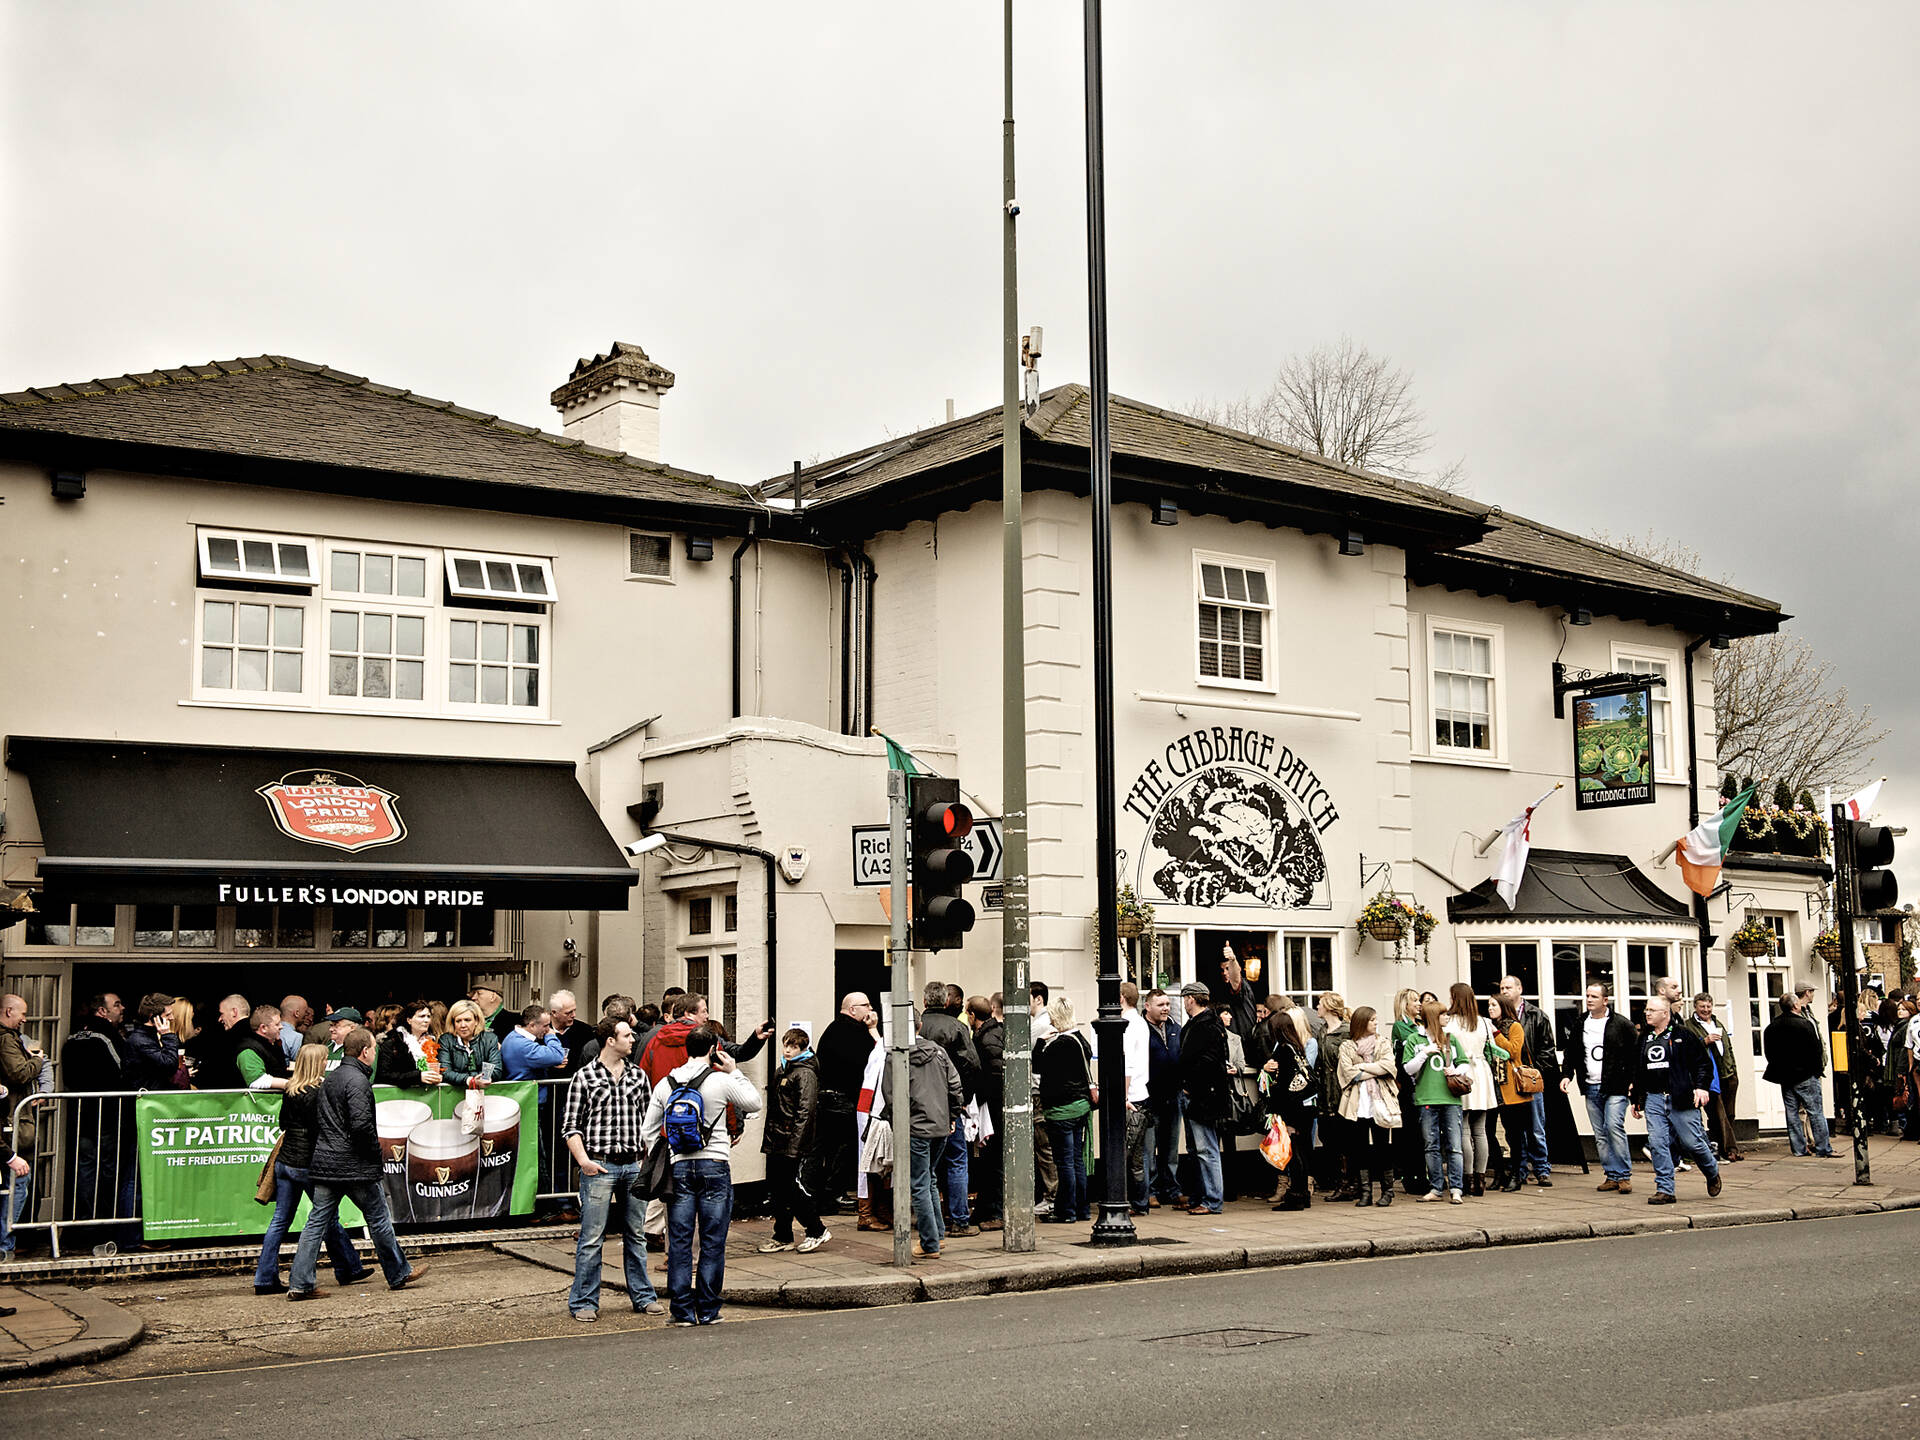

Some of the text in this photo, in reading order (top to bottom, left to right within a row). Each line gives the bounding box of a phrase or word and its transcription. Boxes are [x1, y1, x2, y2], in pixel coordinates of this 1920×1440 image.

[1123, 726, 1340, 835] THE CABBAGE PATCH
[1583, 786, 1648, 803] THE CABBAGE PATCH
[288, 797, 376, 811] LONDON
[304, 808, 369, 818] PRIDE
[219, 884, 484, 906] FULLER'S LONDON PRIDE
[229, 1112, 275, 1123] 17 MARCH
[151, 1124, 282, 1146] ST PATRICK
[166, 1156, 186, 1166] THE
[188, 1154, 248, 1166] FRIENDLIEST
[415, 1179, 471, 1198] GUINNESS
